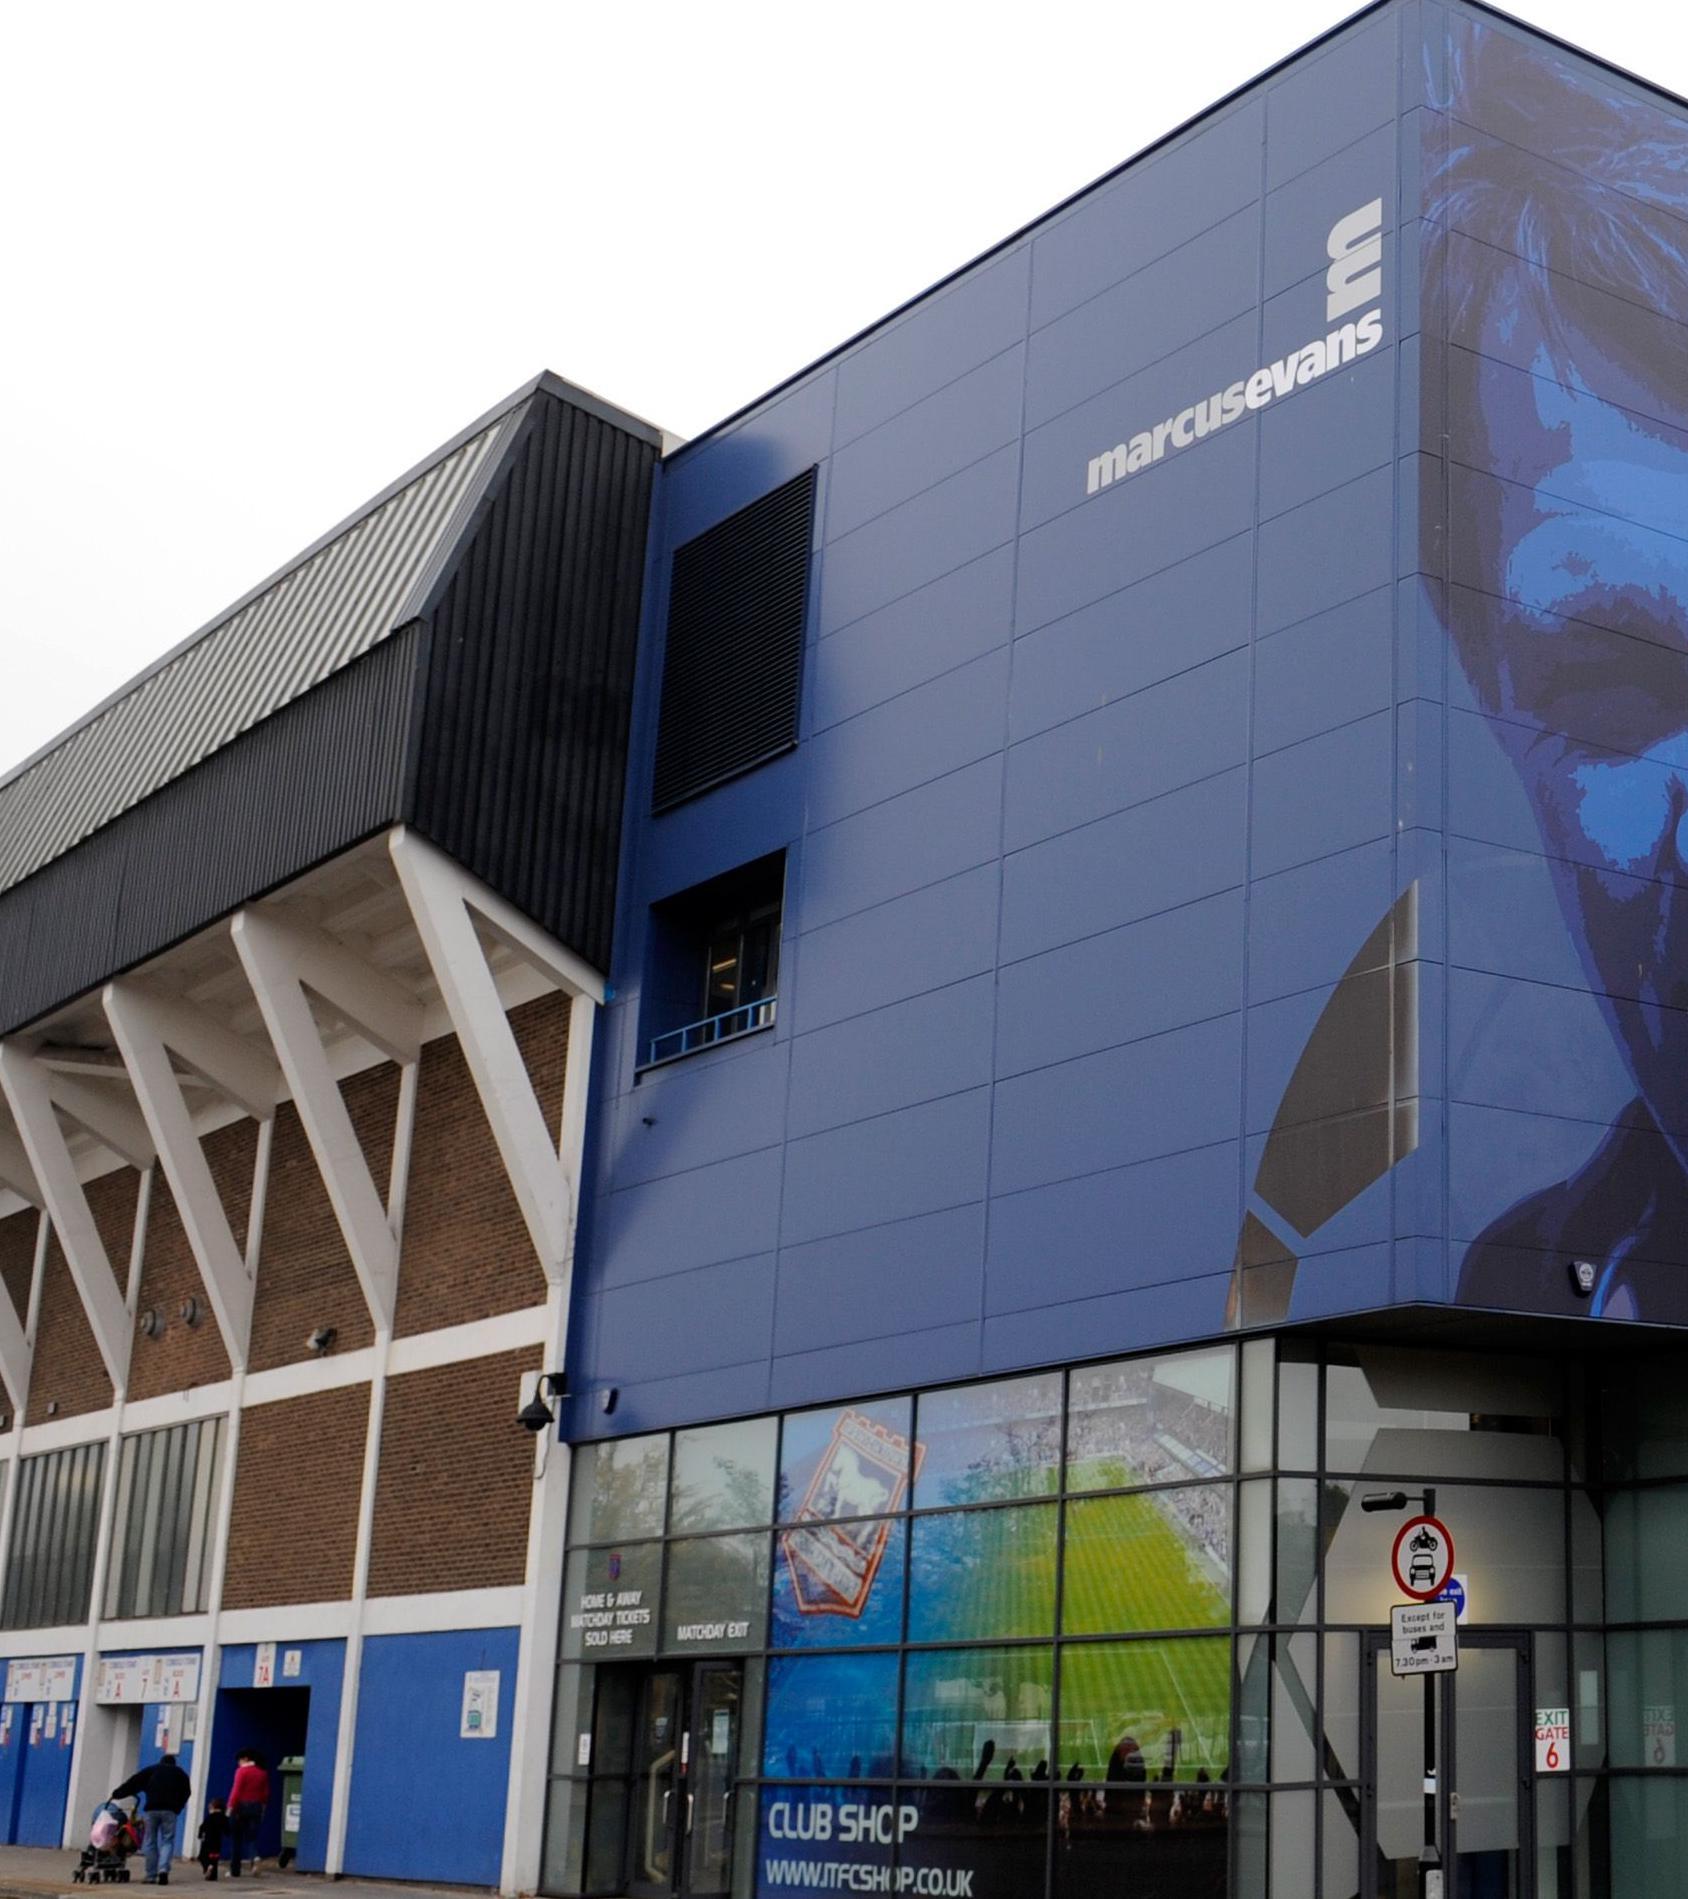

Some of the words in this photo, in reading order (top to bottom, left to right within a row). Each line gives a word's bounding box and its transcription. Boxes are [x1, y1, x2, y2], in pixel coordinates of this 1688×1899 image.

[1087, 308, 1383, 494] marcusevans
[580, 1593, 604, 1609] HOME
[607, 1593, 615, 1607] &
[616, 1591, 642, 1607] AWAY
[571, 1612, 615, 1628] MATCHDAY
[616, 1609, 650, 1625] TICKETS
[1401, 1613, 1430, 1623] Except
[1433, 1611, 1445, 1620] for
[677, 1624, 725, 1640] MATCHDAY
[727, 1622, 749, 1638] EXIT
[1402, 1624, 1427, 1634] buses
[1430, 1622, 1445, 1631] and
[585, 1631, 608, 1646] SOLD
[609, 1629, 633, 1645] HERE
[1536, 1711, 1568, 1725] EXIT
[1535, 1726, 1569, 1740] GATE
[1546, 1742, 1559, 1768] 6
[768, 1802, 832, 1840] CLUB
[839, 1805, 919, 1844] SHOP
[766, 1859, 974, 1897] WWW.ITFCSHOP.CO.UK
